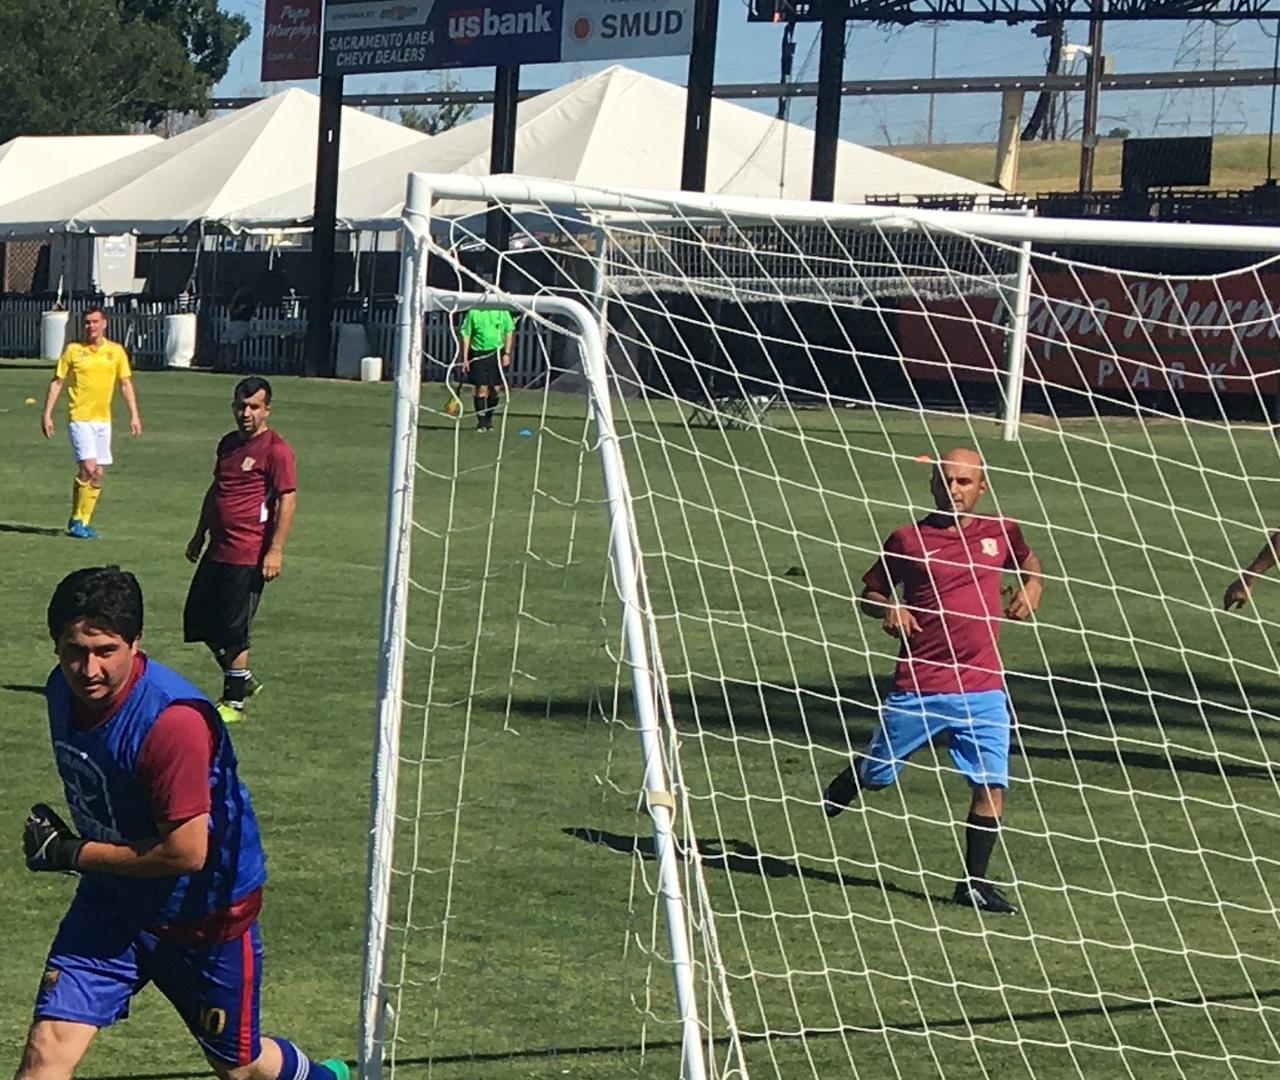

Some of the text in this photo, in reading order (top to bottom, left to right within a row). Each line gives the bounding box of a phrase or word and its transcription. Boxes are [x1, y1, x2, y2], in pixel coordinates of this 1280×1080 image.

[601, 10, 683, 39] SMUD
[329, 30, 435, 51] SACRAMENTO AREA
[336, 47, 426, 66] CHEVY DEALERS
[1097, 359, 1227, 391] PARK
